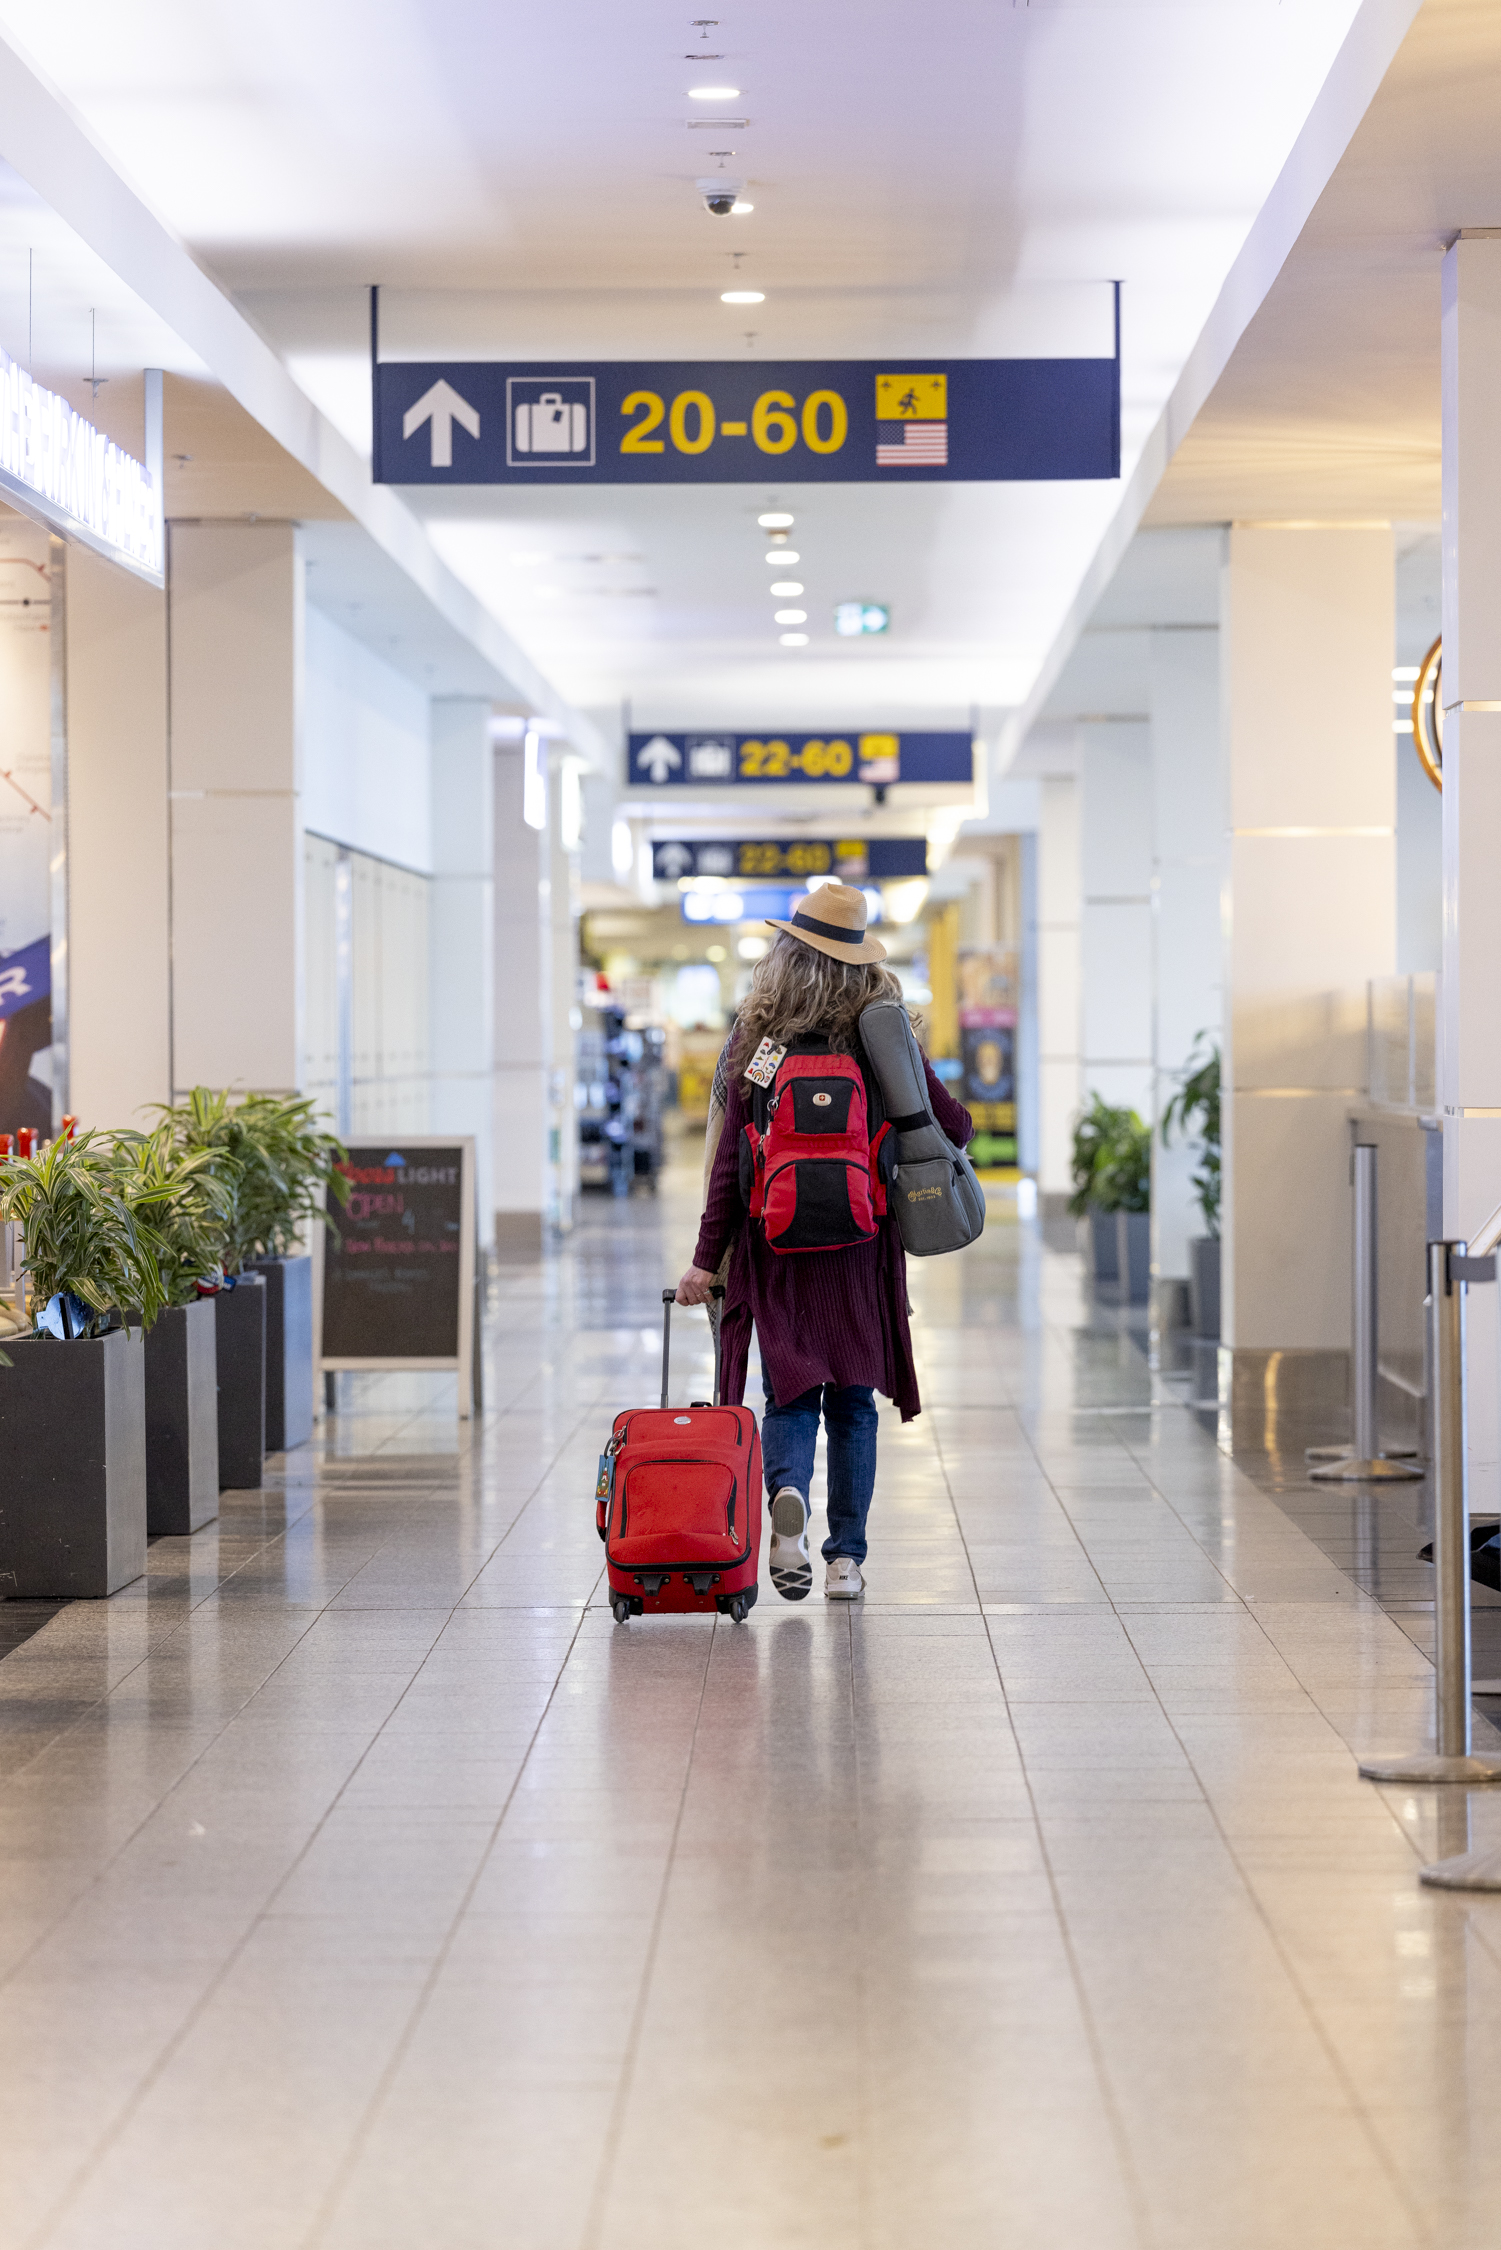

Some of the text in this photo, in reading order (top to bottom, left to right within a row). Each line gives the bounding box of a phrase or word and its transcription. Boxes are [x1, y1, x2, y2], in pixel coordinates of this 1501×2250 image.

[619, 389, 849, 455] 20-60
[739, 739, 853, 777] 22-60
[397, 1166, 458, 1184] LIGHT
